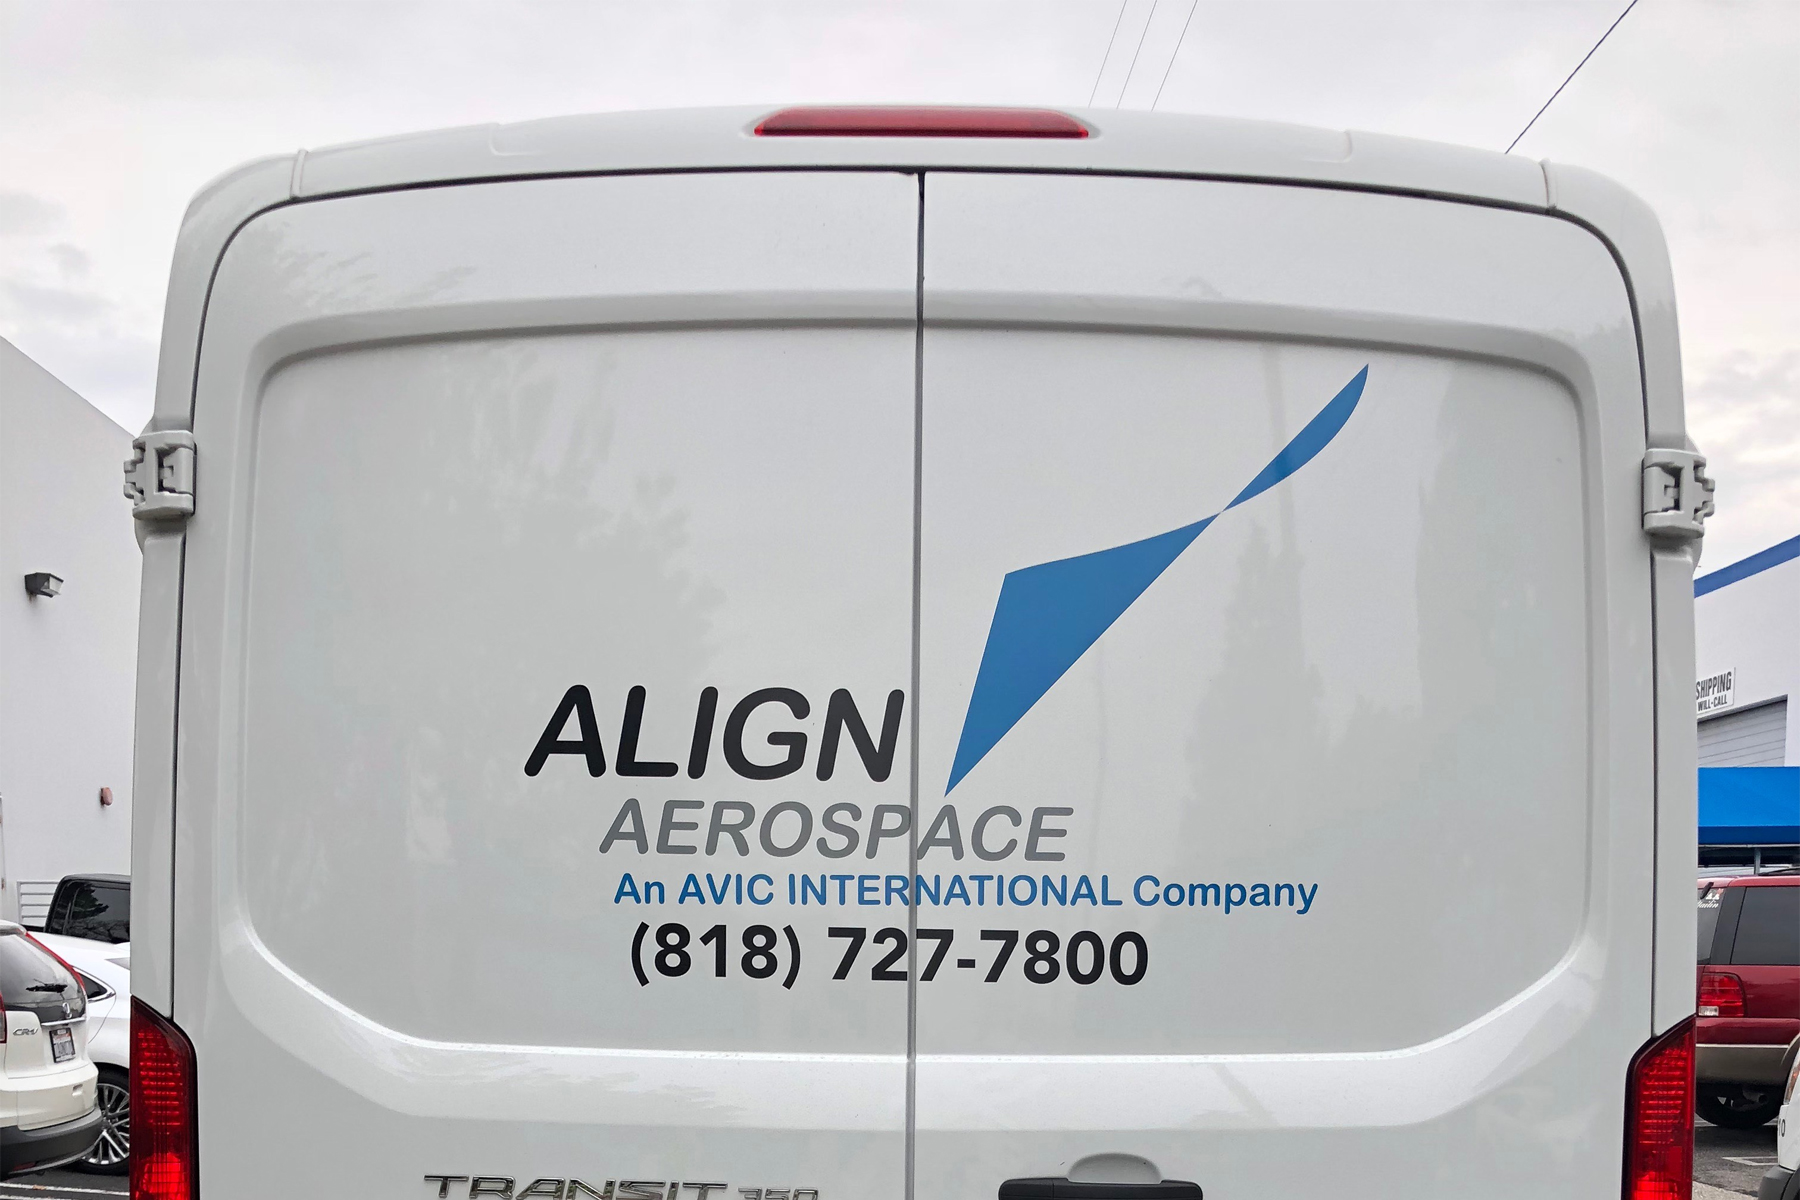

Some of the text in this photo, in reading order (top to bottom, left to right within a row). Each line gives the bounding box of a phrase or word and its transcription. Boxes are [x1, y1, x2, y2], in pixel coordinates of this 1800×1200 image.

[1696, 671, 1732, 700] SHIPPING
[1698, 694, 1727, 711] WILL-CALL
[524, 685, 905, 782] ALIGN
[599, 798, 1074, 861] AEROSPACE
[614, 873, 1318, 914] An AVIC INTERNATIONAL Company
[631, 921, 1149, 990] (818) 727-7800
